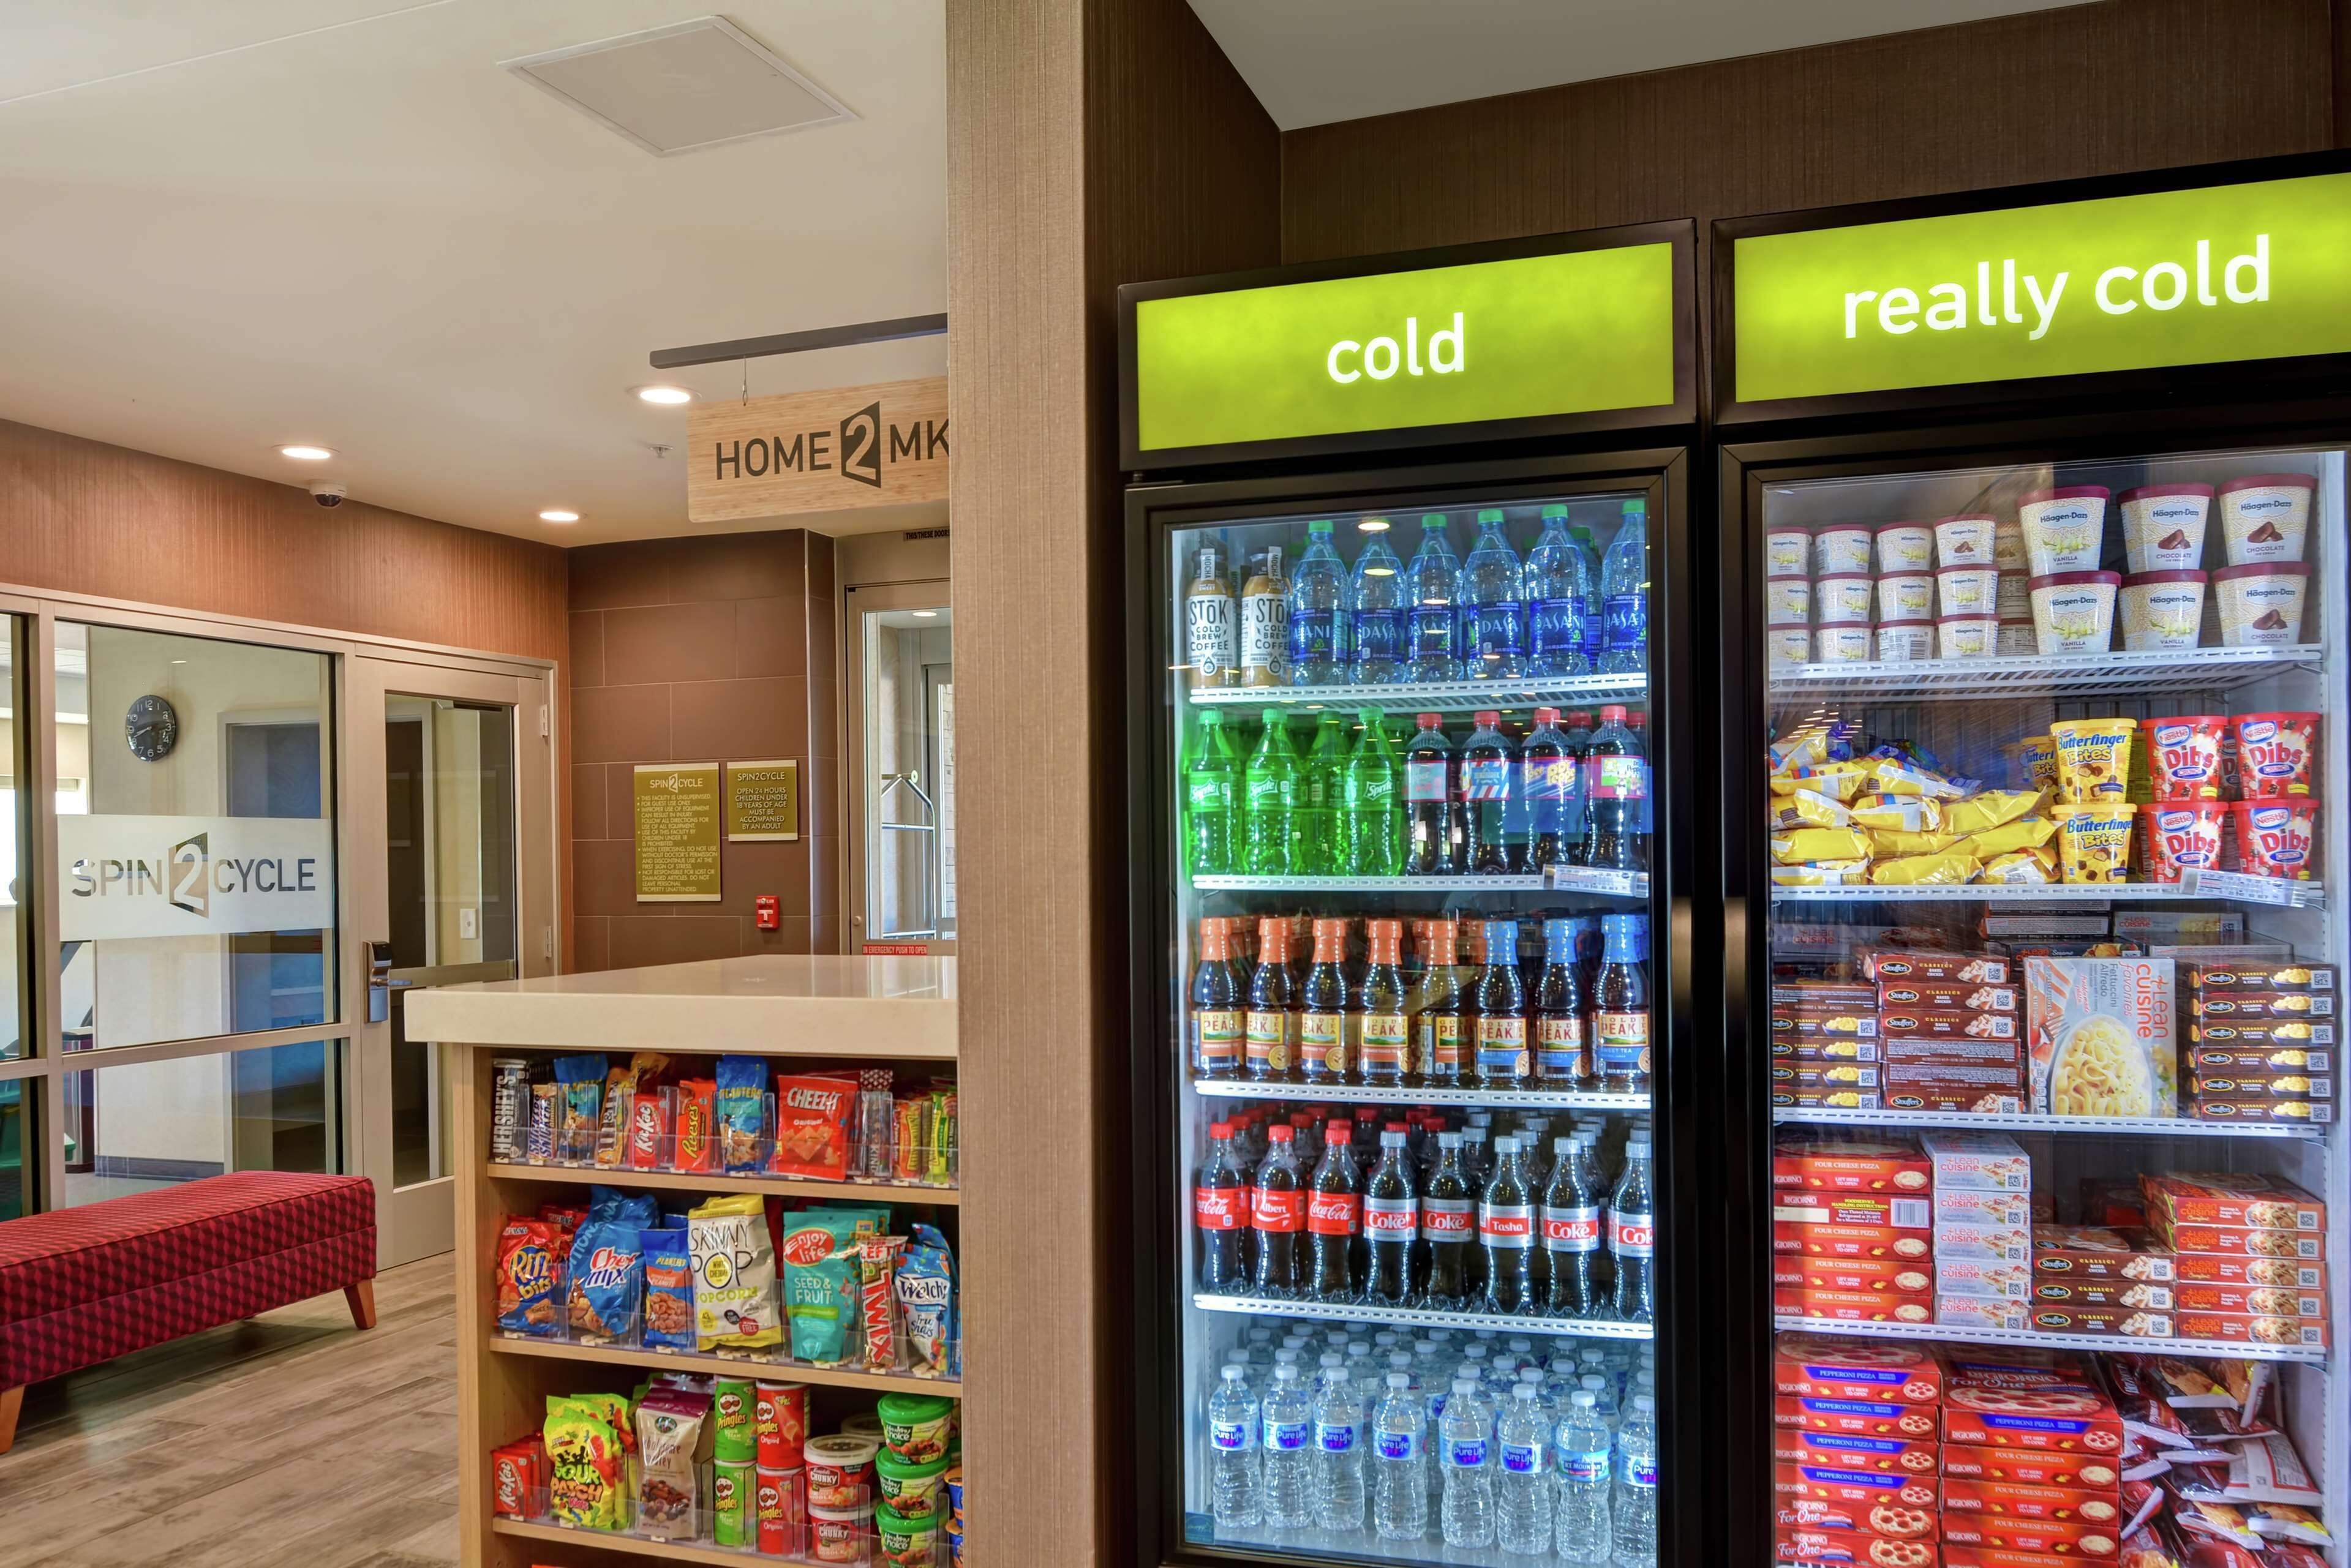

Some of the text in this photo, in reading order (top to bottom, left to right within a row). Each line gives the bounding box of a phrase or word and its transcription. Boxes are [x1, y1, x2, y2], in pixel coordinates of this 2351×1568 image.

[1844, 233, 2269, 340] really cold
[1326, 312, 1465, 384] cold
[1203, 556, 1212, 580] MOCHA
[1190, 641, 1228, 651] COFFEE
[2058, 734, 2126, 751] Butterfinger
[2067, 748, 2112, 765] Bites
[2163, 745, 2214, 770] Dibs
[2249, 741, 2303, 765] Dibs
[737, 772, 786, 781] SPIN2CYCLE
[2082, 833, 2124, 849] Bites
[2166, 830, 2216, 855] Dibs
[2259, 828, 2310, 853] Dibs
[2153, 991, 2169, 1038] Lean
[1369, 1212, 1407, 1229] Coke
[1427, 1213, 1465, 1229] Coke
[1492, 1221, 1523, 1232] Tasha
[1549, 1222, 1590, 1239] Coke
[799, 1246, 826, 1262] life
[794, 1278, 821, 1289] SEED
[796, 1290, 832, 1305] FRUIT
[864, 1270, 894, 1364] TWIX
[1820, 1370, 1855, 1379] PEPPERONI
[717, 1412, 746, 1431] Pringles
[810, 1471, 837, 1485] CHUNKY
[1778, 1510, 1821, 1524] For One
